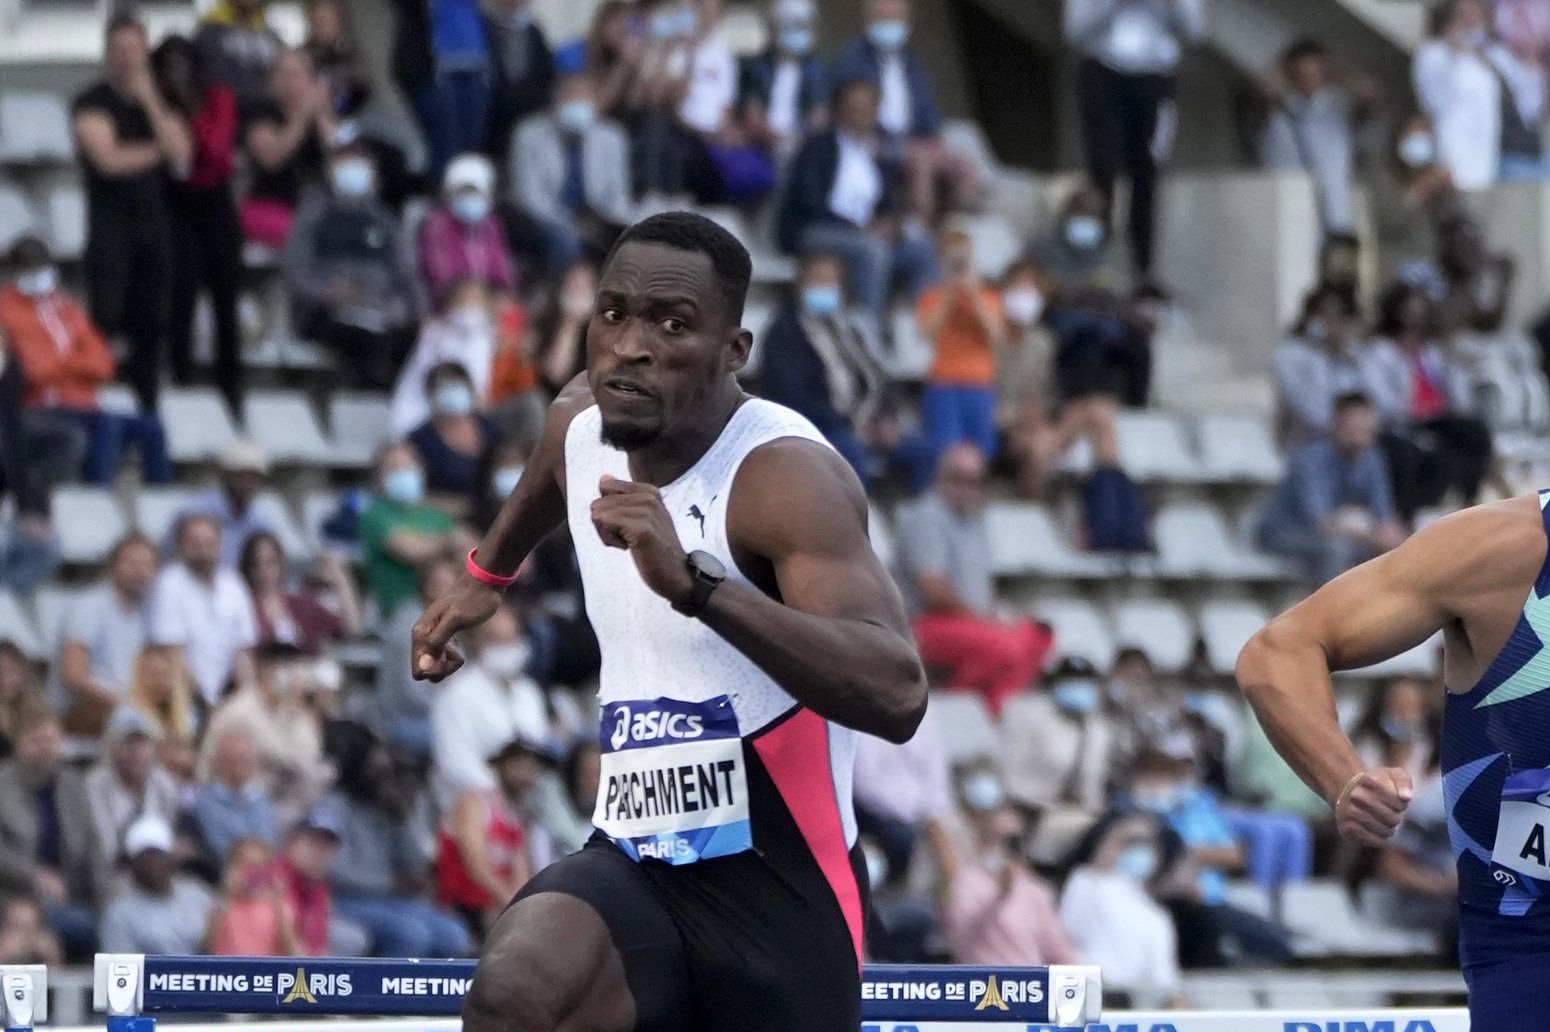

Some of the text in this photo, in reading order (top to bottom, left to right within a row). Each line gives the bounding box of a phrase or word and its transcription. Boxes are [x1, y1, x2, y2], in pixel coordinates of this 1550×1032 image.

[631, 711, 704, 741] asics
[604, 759, 735, 821] PARCHMENT
[638, 838, 691, 858] PARIS
[149, 968, 353, 1003] MEETING DE PARIS
[381, 977, 474, 996] MEETIN
[861, 975, 1044, 1011] EETING DE PARIS
